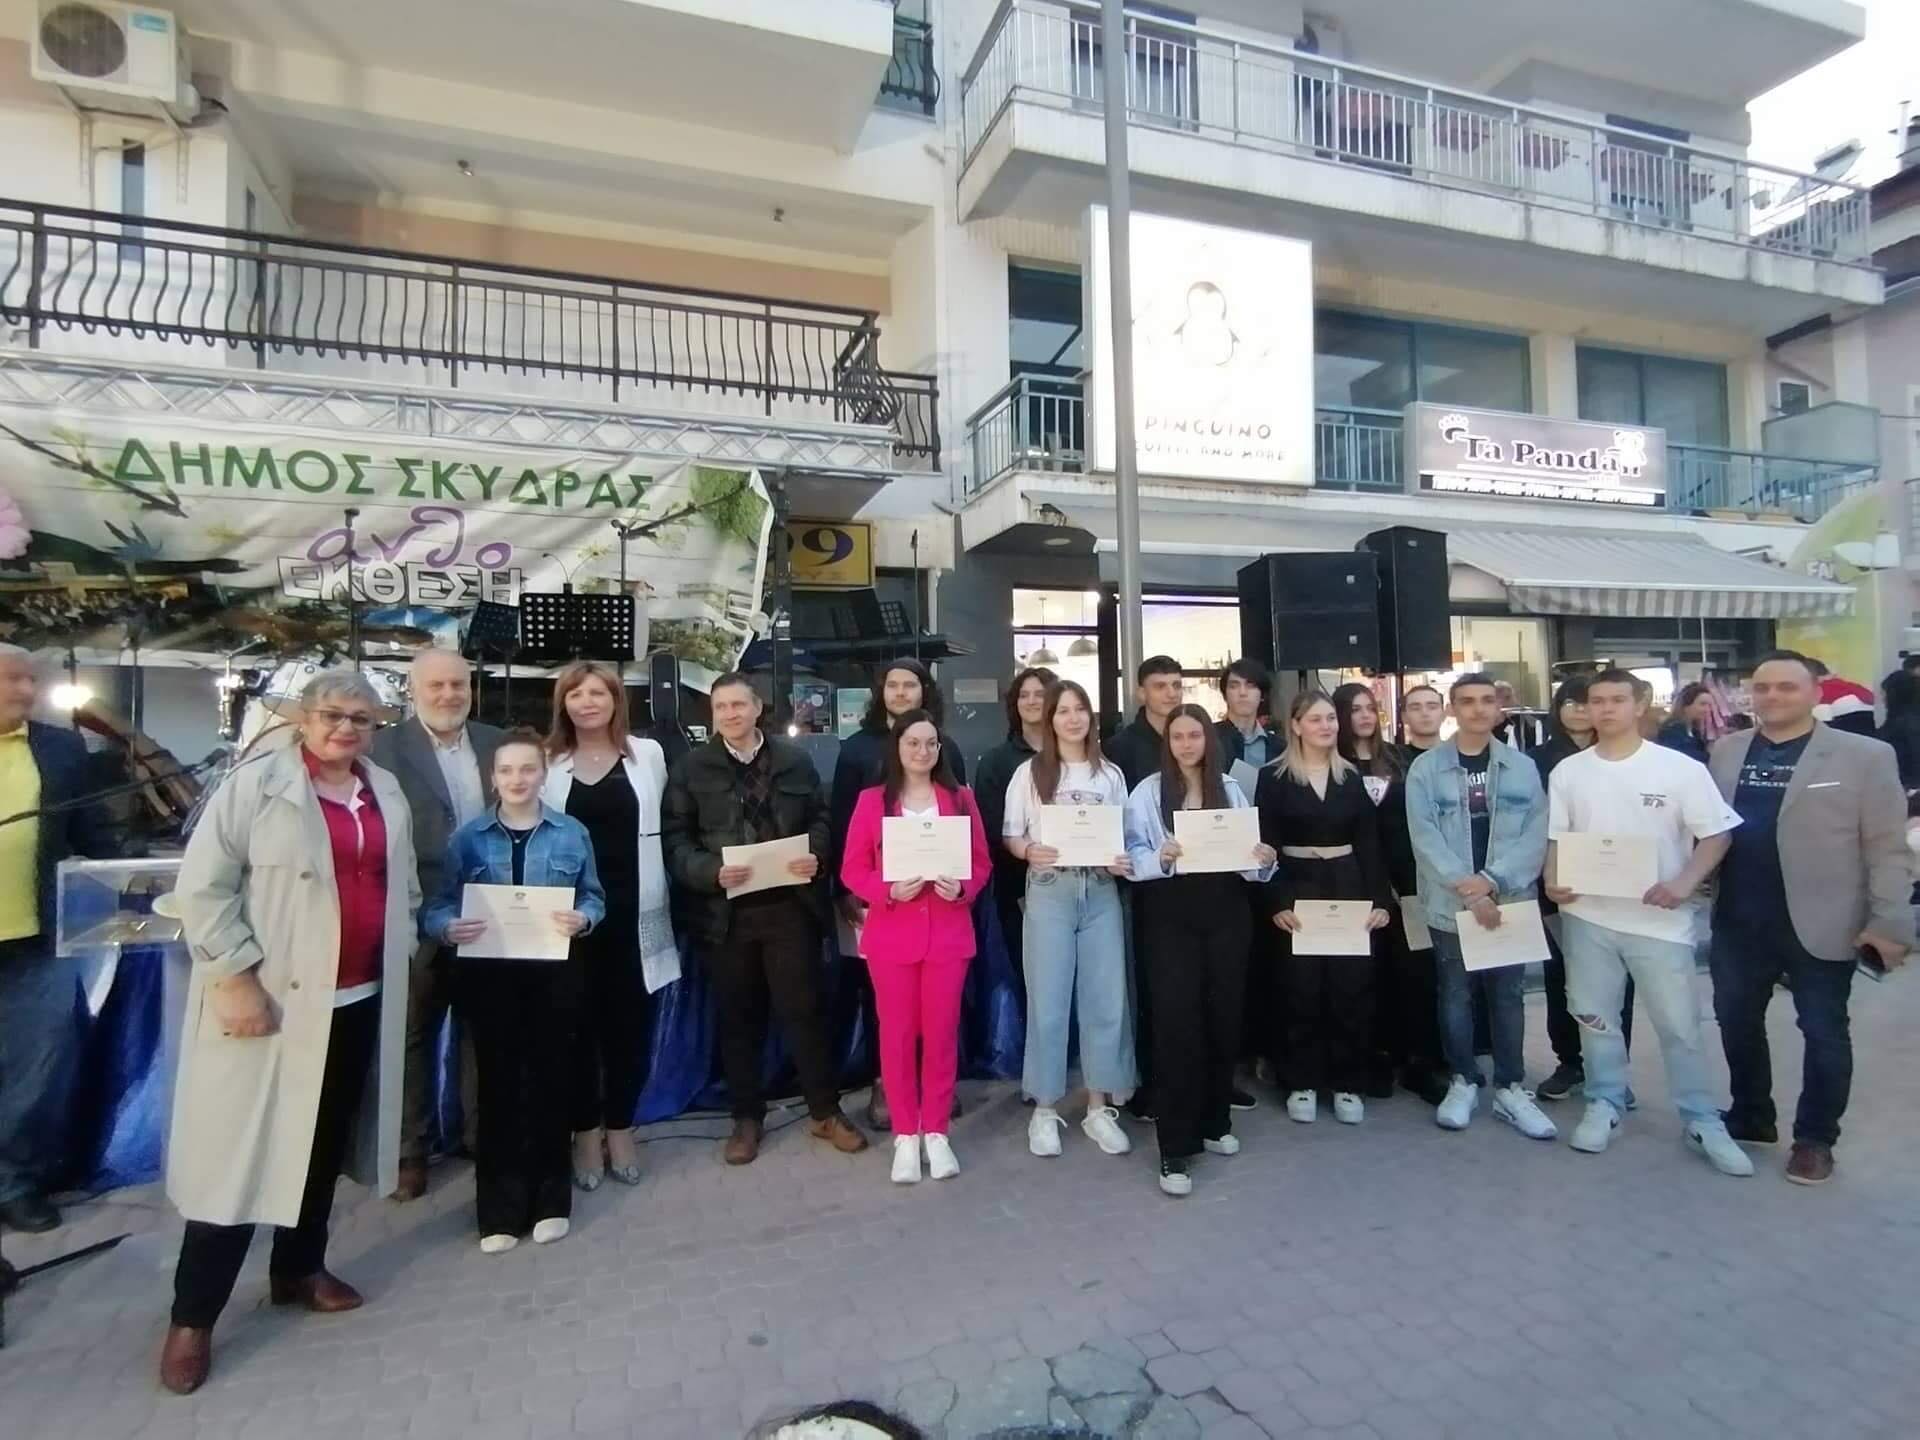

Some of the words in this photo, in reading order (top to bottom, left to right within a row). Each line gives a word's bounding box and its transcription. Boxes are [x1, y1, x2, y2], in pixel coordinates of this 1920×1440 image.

[114, 438, 375, 495] ΔΗΜΟΣ
[395, 457, 654, 510] ΣΚΥΔΡΑΣ
[1514, 442, 1618, 472] Panda
[277, 554, 522, 608] ΕΚΘΕΣΗ
